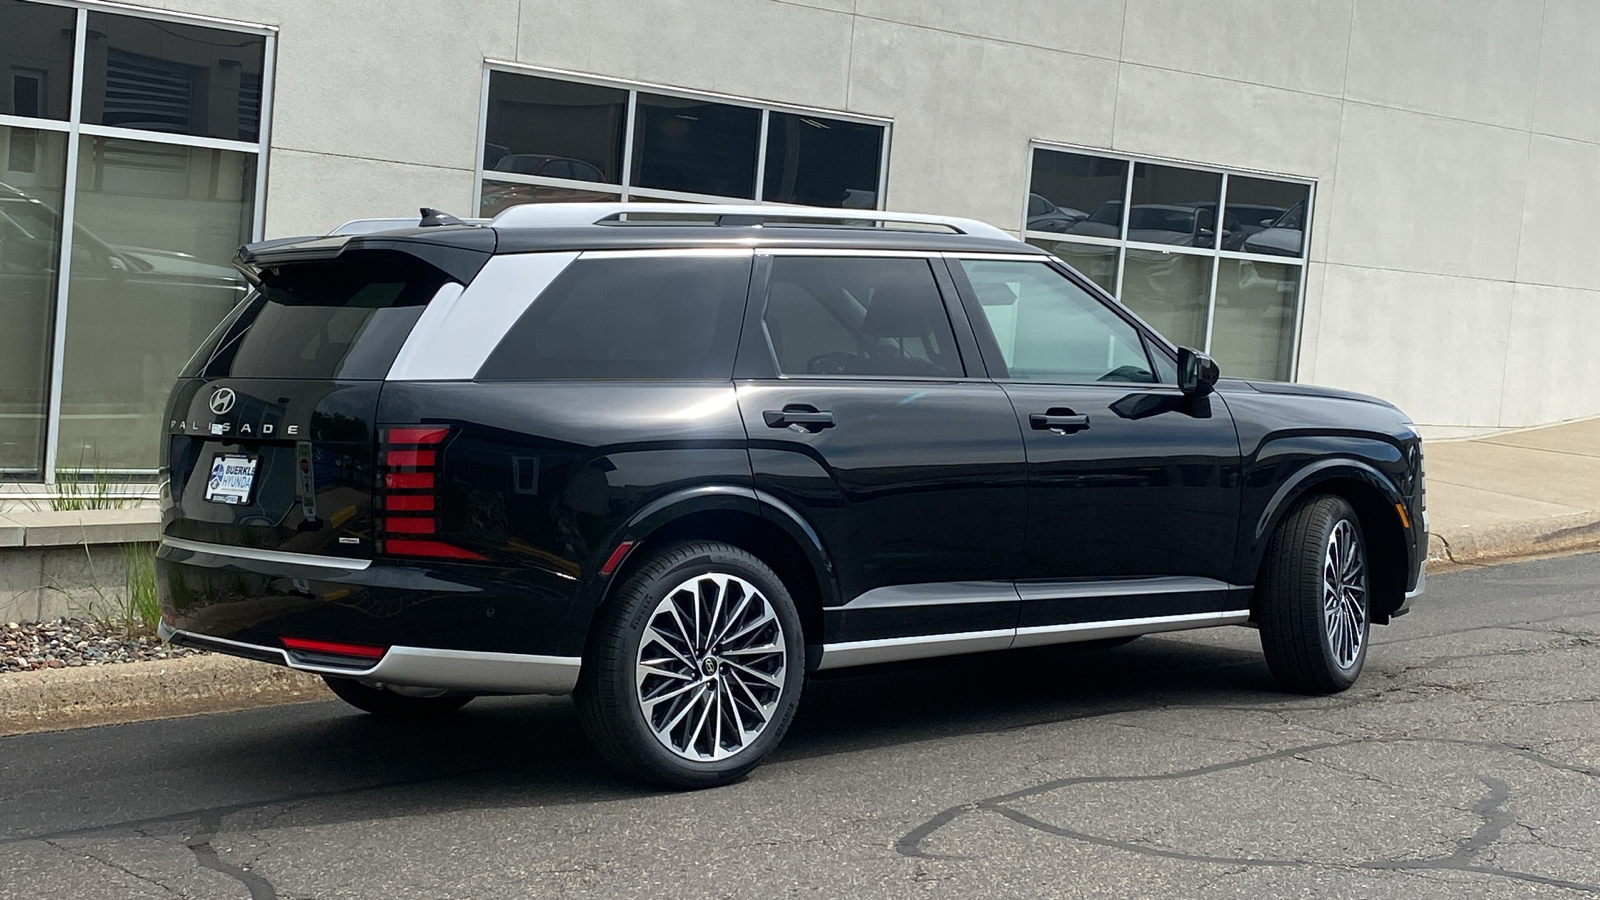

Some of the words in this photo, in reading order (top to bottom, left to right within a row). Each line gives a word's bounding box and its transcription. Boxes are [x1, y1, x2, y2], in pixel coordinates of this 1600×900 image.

[170, 420, 299, 435] PALISADE
[225, 465, 256, 476] BUERKLE
[221, 475, 251, 489] HYUNDA
